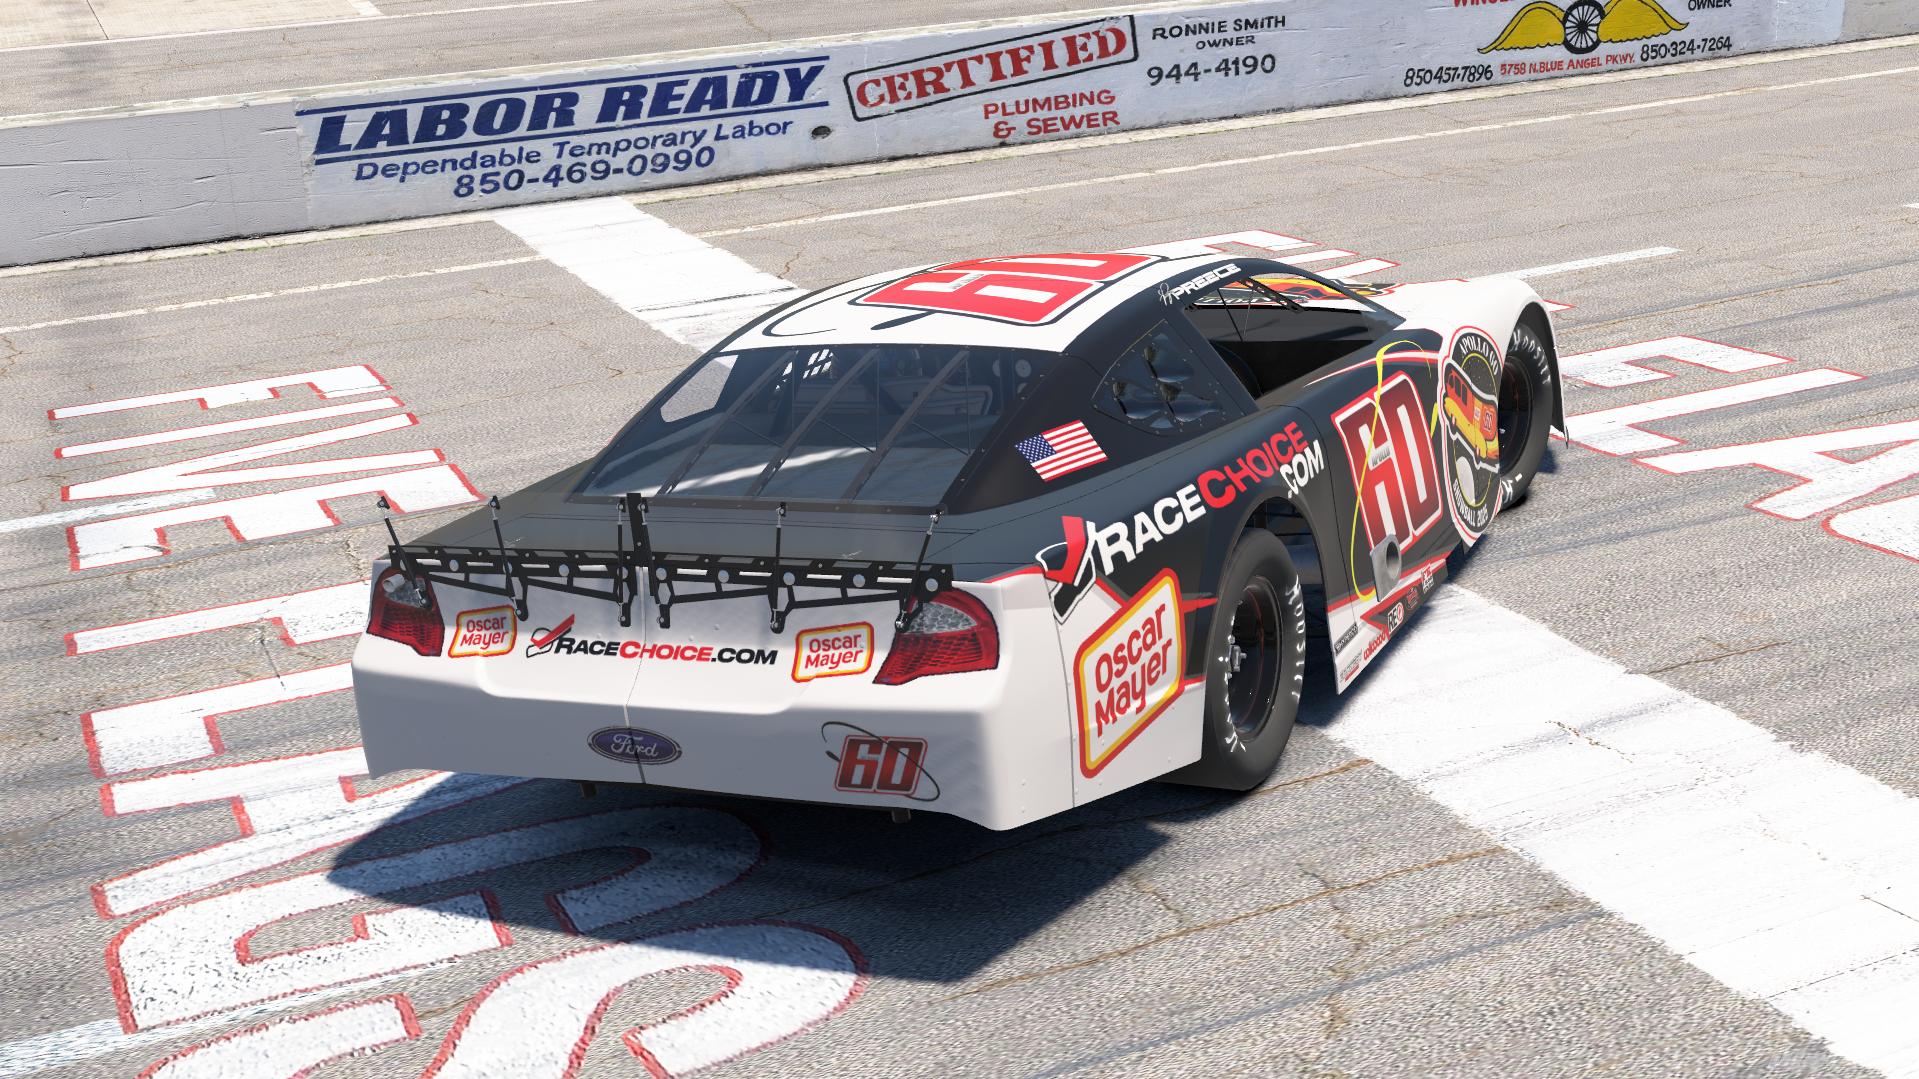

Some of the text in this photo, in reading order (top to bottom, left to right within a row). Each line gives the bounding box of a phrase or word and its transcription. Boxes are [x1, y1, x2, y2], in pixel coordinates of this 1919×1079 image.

[1151, 15, 1286, 40] RONNIE SMITH
[1195, 35, 1256, 50] OWNER
[855, 27, 1127, 109] CERTIFIED
[1147, 53, 1277, 86] 944-4190
[1500, 62, 1527, 76] 5758
[1566, 57, 1602, 70] ANGEL
[314, 65, 826, 155] LABOR READY
[983, 89, 1116, 120] PLUMBING
[993, 110, 1121, 139] & SEWER
[354, 118, 794, 184] Dependable Temporary Labor
[453, 144, 716, 198] 850-469-0990
[1171, 263, 1242, 300] PREECE
[47, 364, 486, 571] FIVE
[1279, 439, 1325, 498] .COM
[1333, 374, 1442, 555] 60
[460, 630, 510, 651] Mayer
[466, 616, 508, 633] Oscar
[804, 649, 864, 670] Mayer
[809, 633, 862, 653] Oscar
[1094, 603, 1167, 694] Oscar
[1094, 638, 1173, 738] Mayer
[610, 733, 660, 758] Ford
[836, 735, 928, 795] 60
